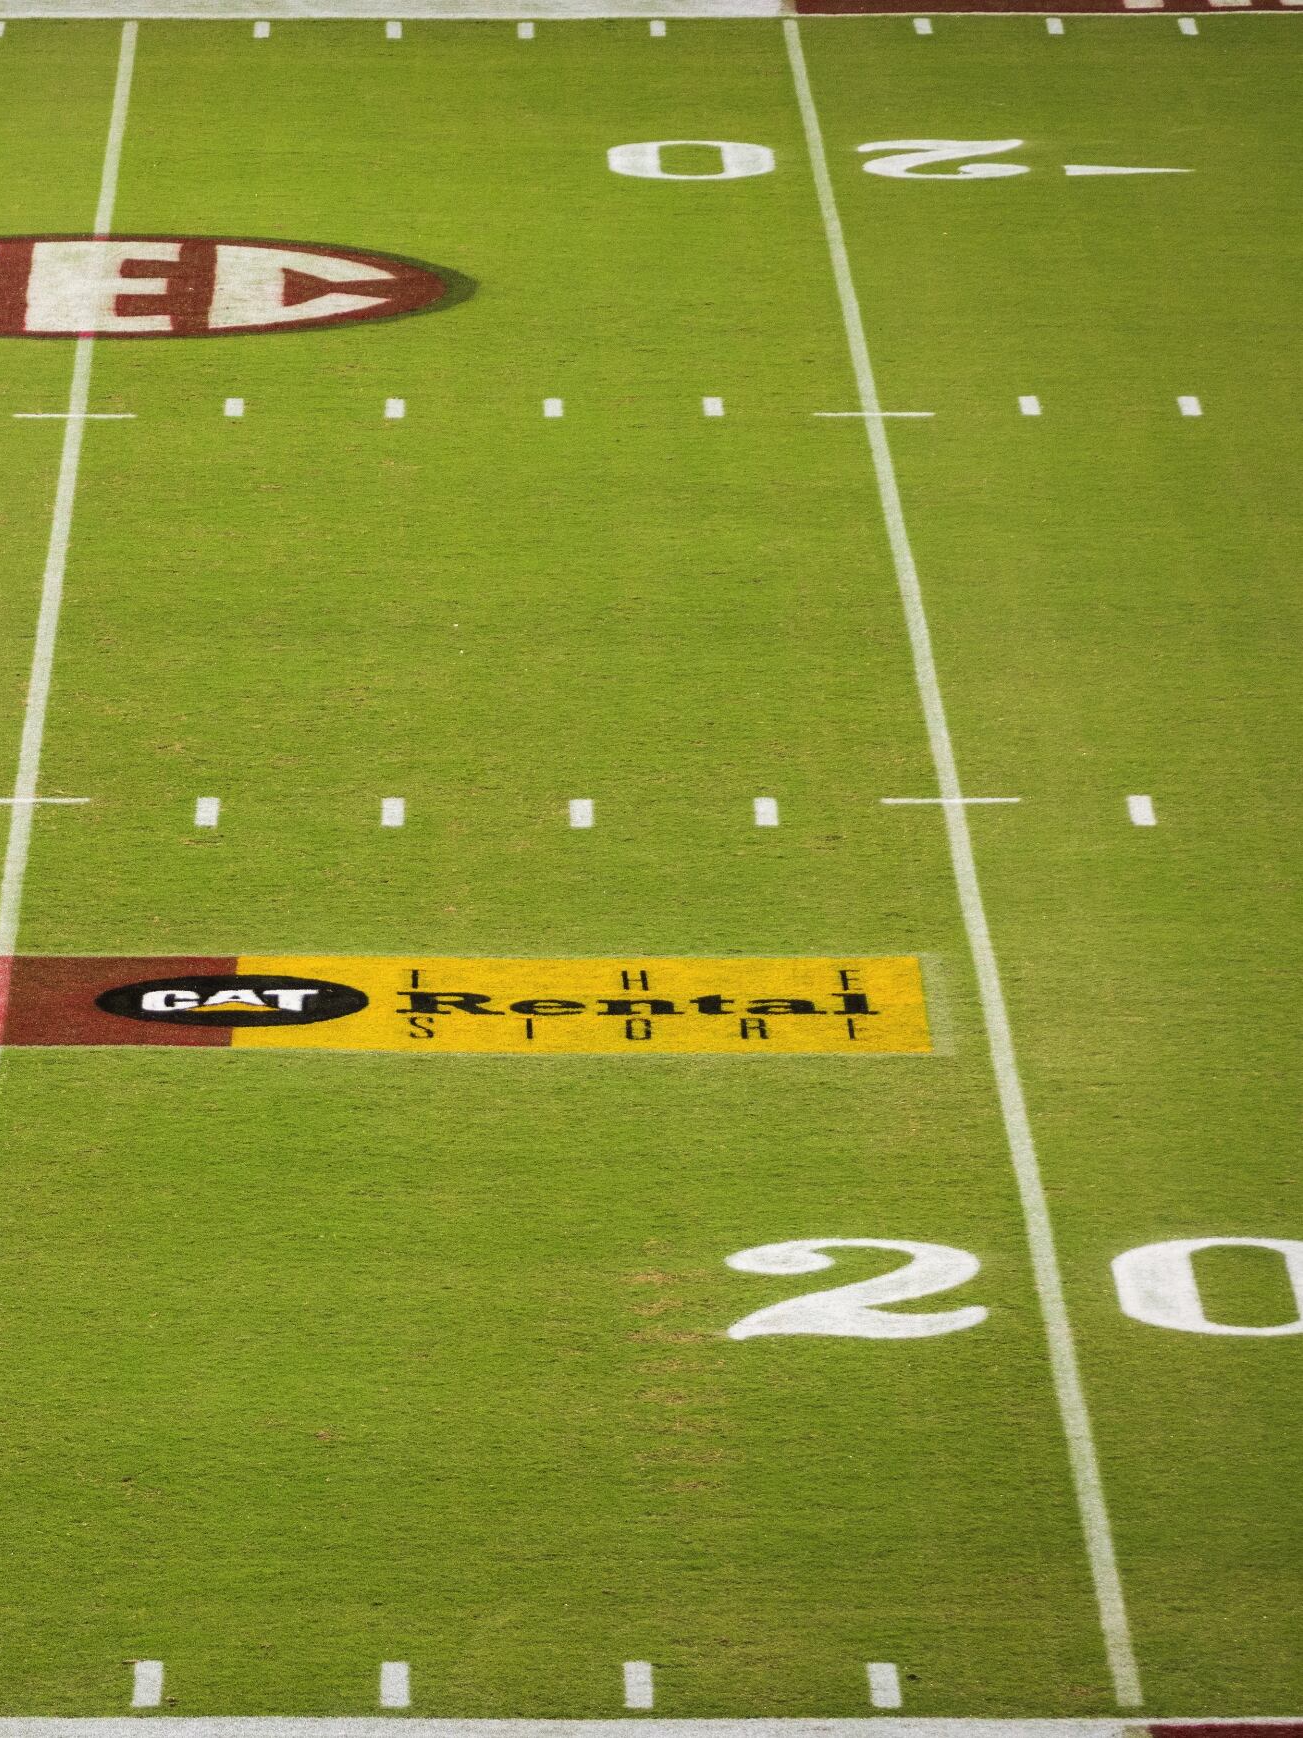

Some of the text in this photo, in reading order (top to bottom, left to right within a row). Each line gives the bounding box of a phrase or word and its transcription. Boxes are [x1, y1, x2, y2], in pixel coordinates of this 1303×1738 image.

[606, 140, 1031, 181] 20
[141, 988, 319, 1012] CAT
[396, 990, 879, 1015] Rental
[724, 1236, 1303, 1340] 20
